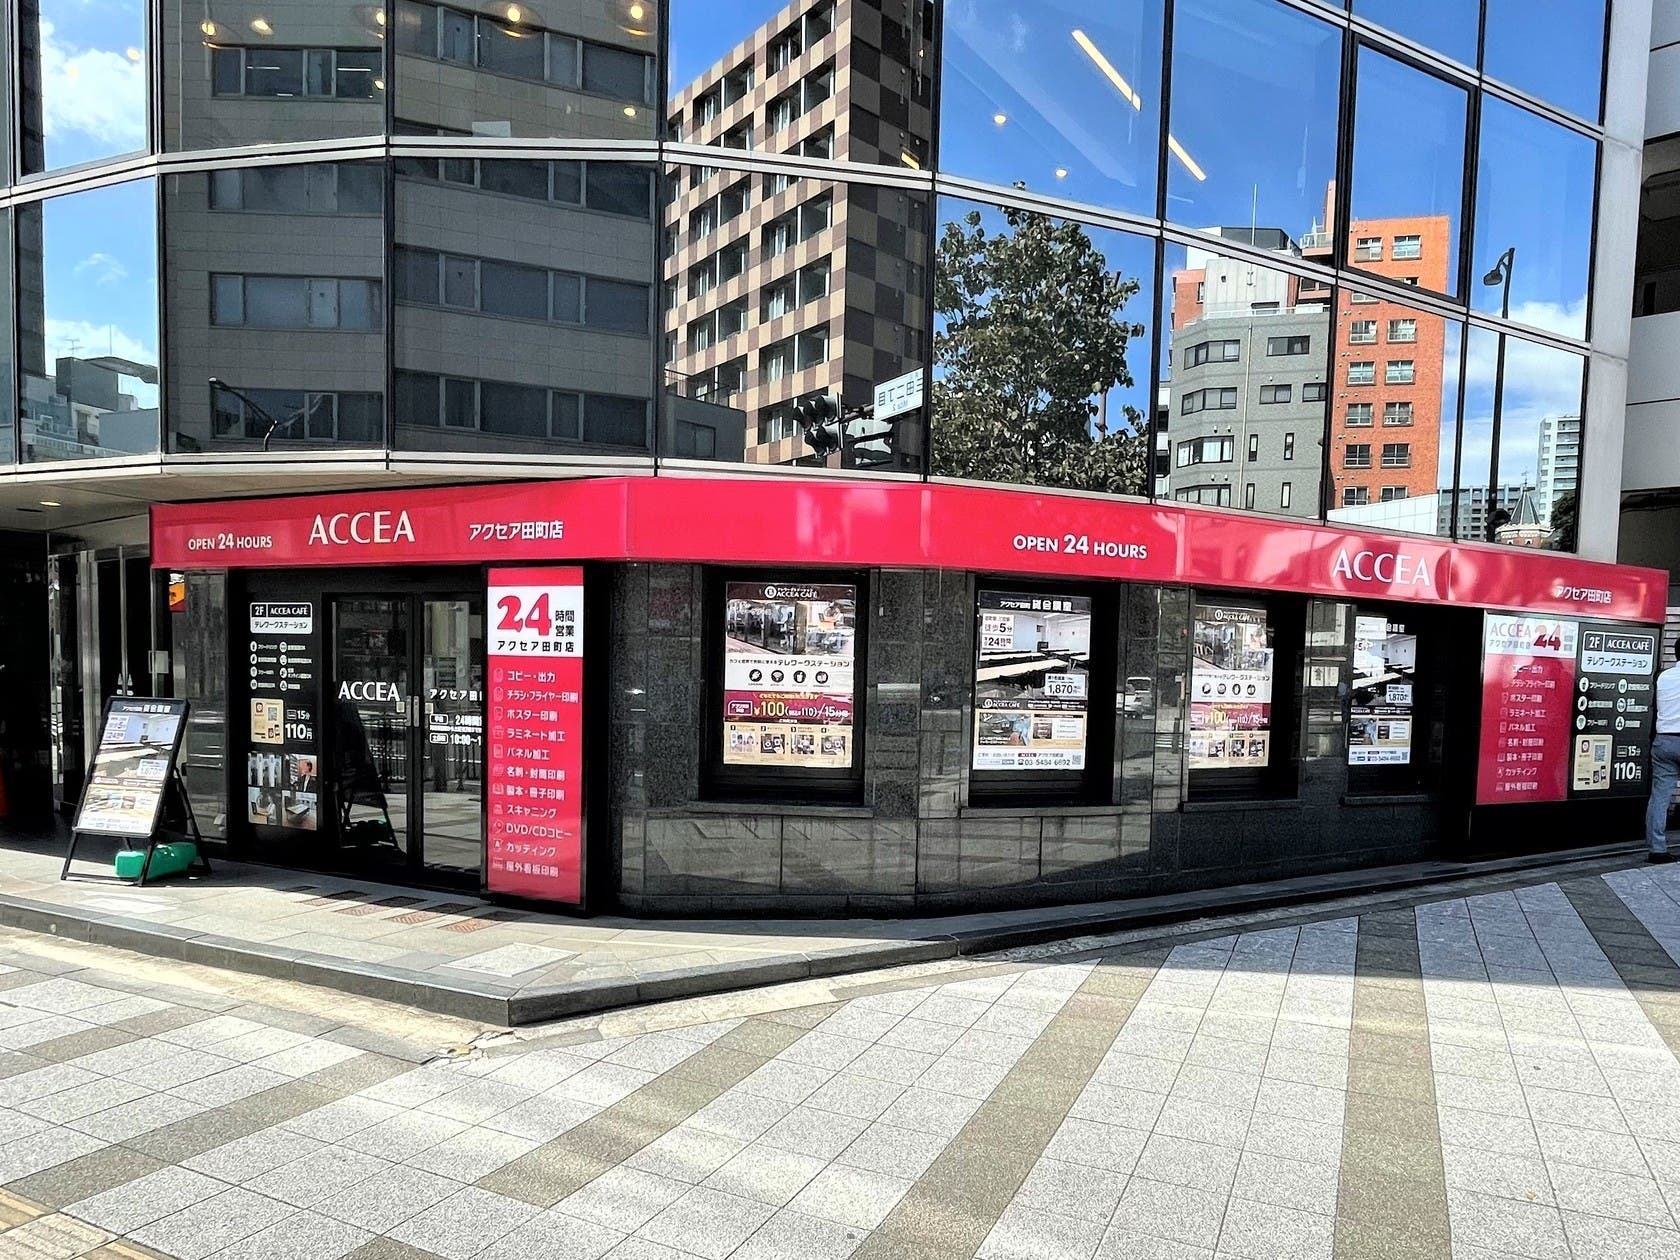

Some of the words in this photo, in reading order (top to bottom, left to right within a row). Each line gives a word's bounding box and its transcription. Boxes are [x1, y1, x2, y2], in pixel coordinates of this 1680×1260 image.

[308, 509, 416, 546] ACCEA
[469, 519, 564, 542] アクセア田町店
[187, 537, 216, 551] OPEN
[217, 532, 234, 550] 24
[236, 535, 273, 549] HOURS
[1013, 534, 1059, 553] OPEN
[1063, 533, 1089, 555] 24
[1093, 541, 1148, 560] HOURS
[1331, 548, 1432, 587] ACCEA
[1555, 585, 1612, 604] アクセア田町店
[254, 606, 265, 616] 2F
[497, 592, 552, 637] 24
[555, 610, 575, 622] 時間
[555, 625, 575, 637] 営業
[1533, 624, 1561, 651] 24
[497, 640, 575, 653] アクセア田町店
[1589, 636, 1601, 649] 2F
[1607, 639, 1631, 649] ACCEA
[1586, 656, 1648, 668] テレワークステーション
[507, 671, 556, 683] コピー・出力
[338, 680, 400, 702] ACCEA
[507, 690, 579, 703] チラシ・フライヤー印刷
[507, 728, 566, 742] ラミネート加工
[507, 804, 557, 818] スキャニング
[506, 823, 573, 839] DVD/CDコピー
[506, 842, 556, 857] カッティング
